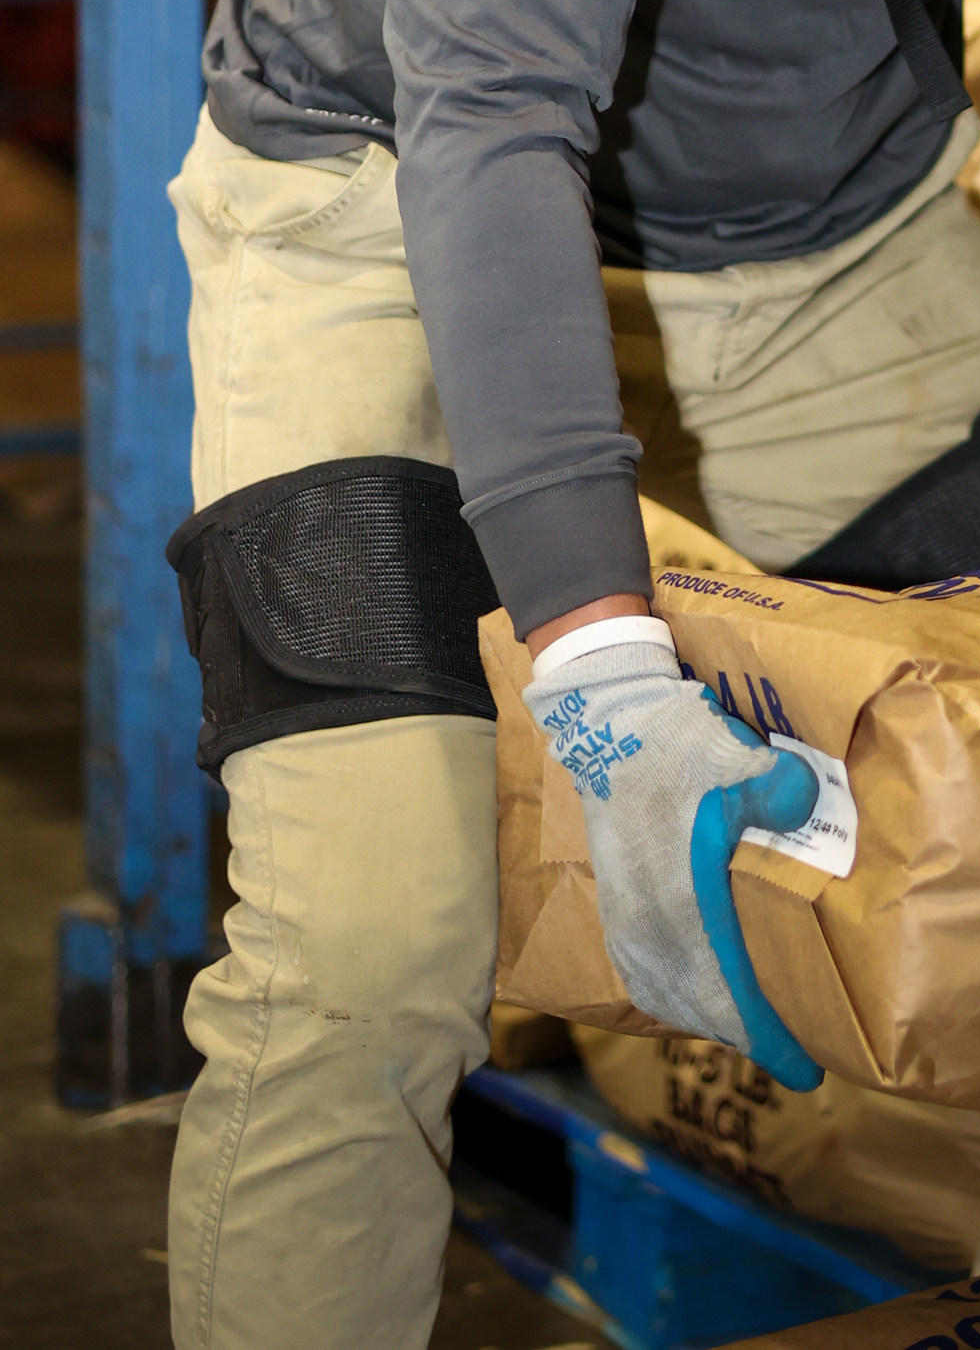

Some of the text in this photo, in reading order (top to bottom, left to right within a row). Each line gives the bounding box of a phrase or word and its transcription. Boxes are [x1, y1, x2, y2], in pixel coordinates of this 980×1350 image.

[656, 572, 727, 595] PRODUCE
[722, 587, 749, 600] OF
[561, 721, 614, 774] ATLAS
[832, 824, 849, 843] Poly
